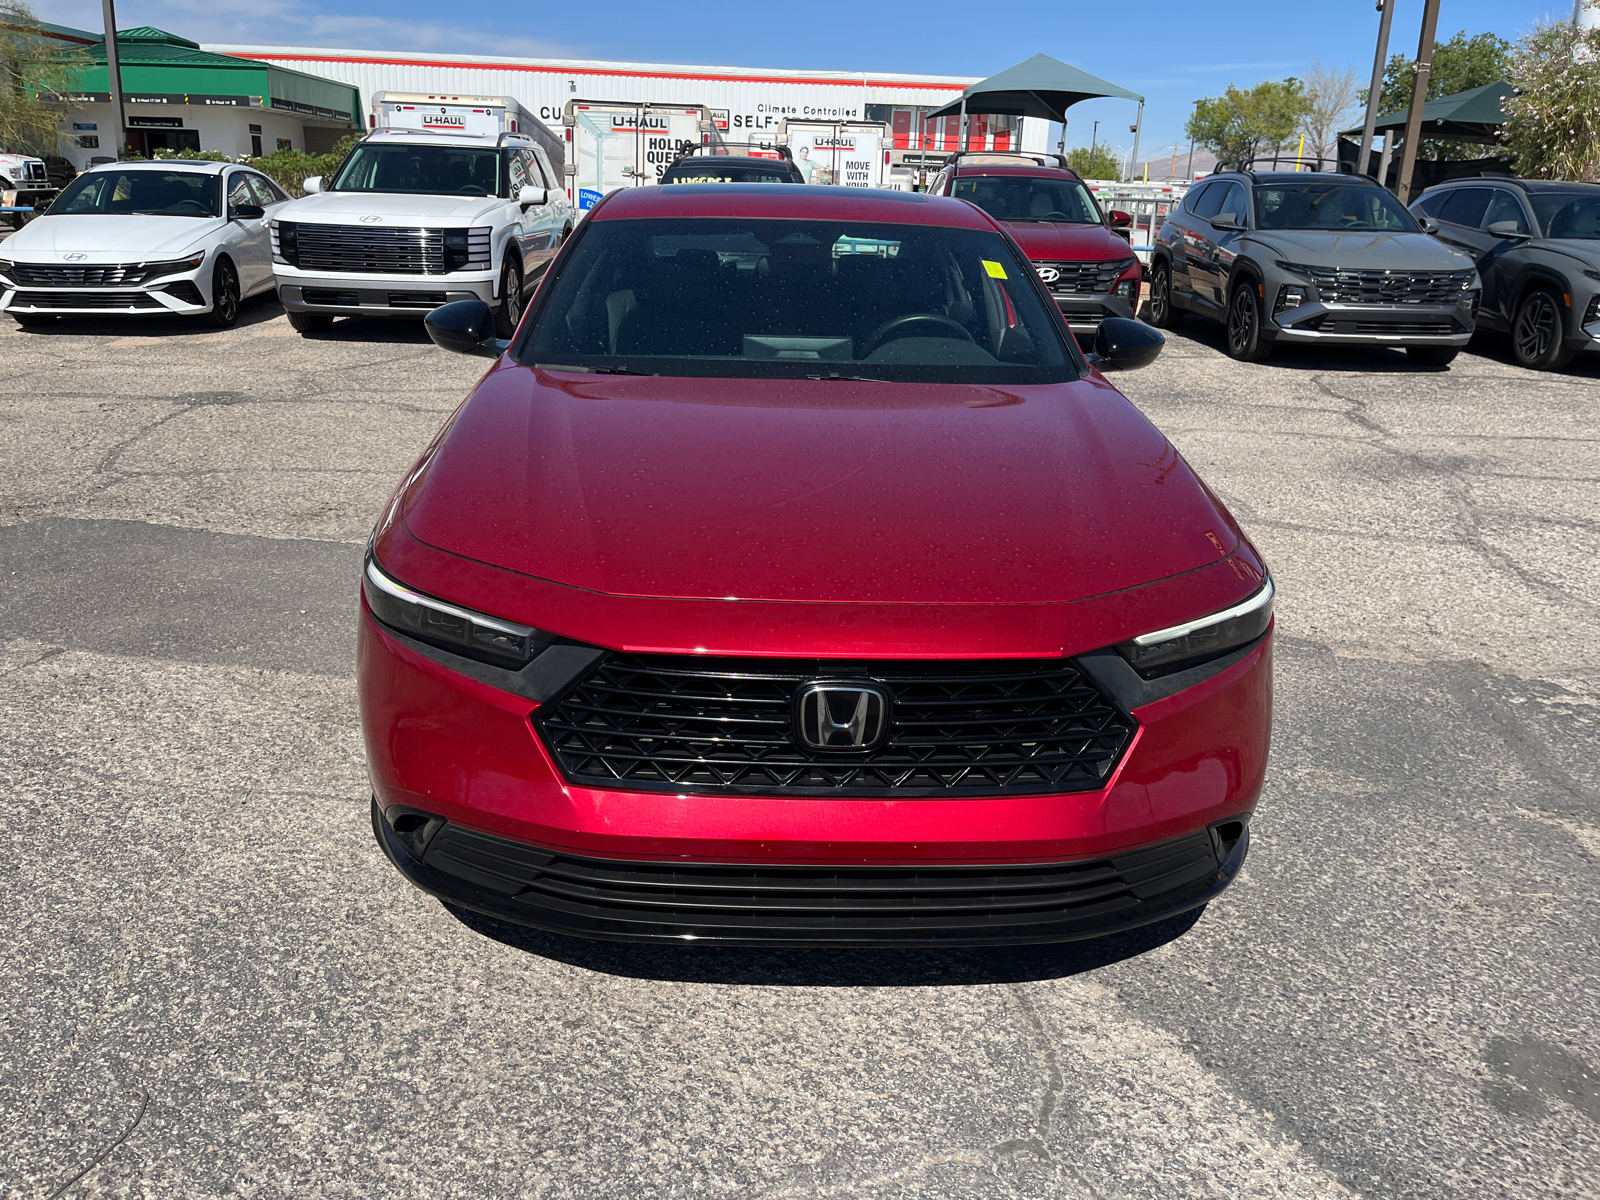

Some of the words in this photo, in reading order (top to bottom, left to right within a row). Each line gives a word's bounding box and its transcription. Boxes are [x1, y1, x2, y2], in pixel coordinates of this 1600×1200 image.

[757, 103, 797, 114] Climate
[803, 105, 857, 117] Controlled
[423, 115, 464, 126] U-HAUL
[612, 116, 668, 129] U-HAUL
[815, 138, 854, 147] U-HAUL
[845, 160, 871, 171] MOVE
[846, 171, 869, 181] WITH
[580, 190, 602, 203] LOWES
